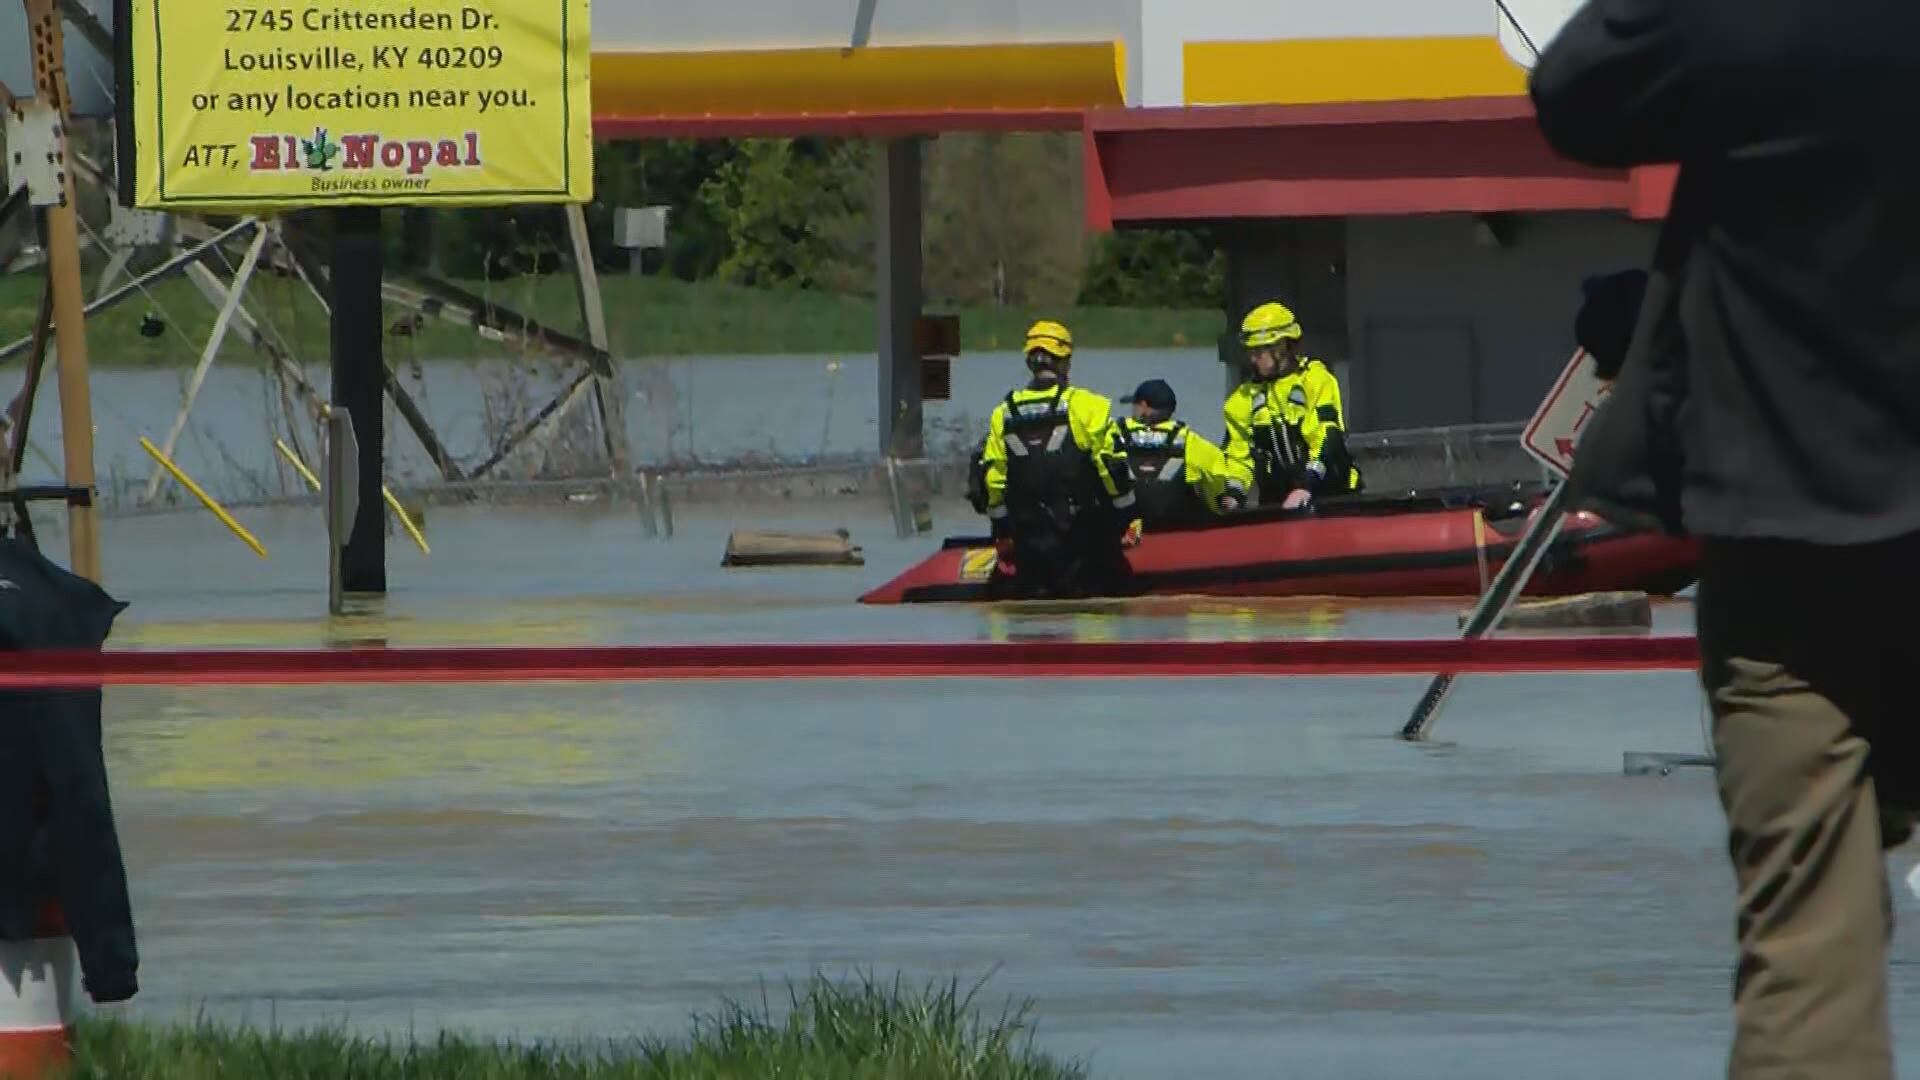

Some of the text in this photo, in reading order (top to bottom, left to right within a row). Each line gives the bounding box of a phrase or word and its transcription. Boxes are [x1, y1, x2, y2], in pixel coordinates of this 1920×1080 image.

[226, 7, 499, 32] 2745 Crittenden Dr.
[224, 46, 503, 72] Louisville, KY 40209
[192, 85, 536, 116] or any location near you.
[183, 132, 481, 173] ATT, El Nopal
[311, 176, 431, 193] Business owner
